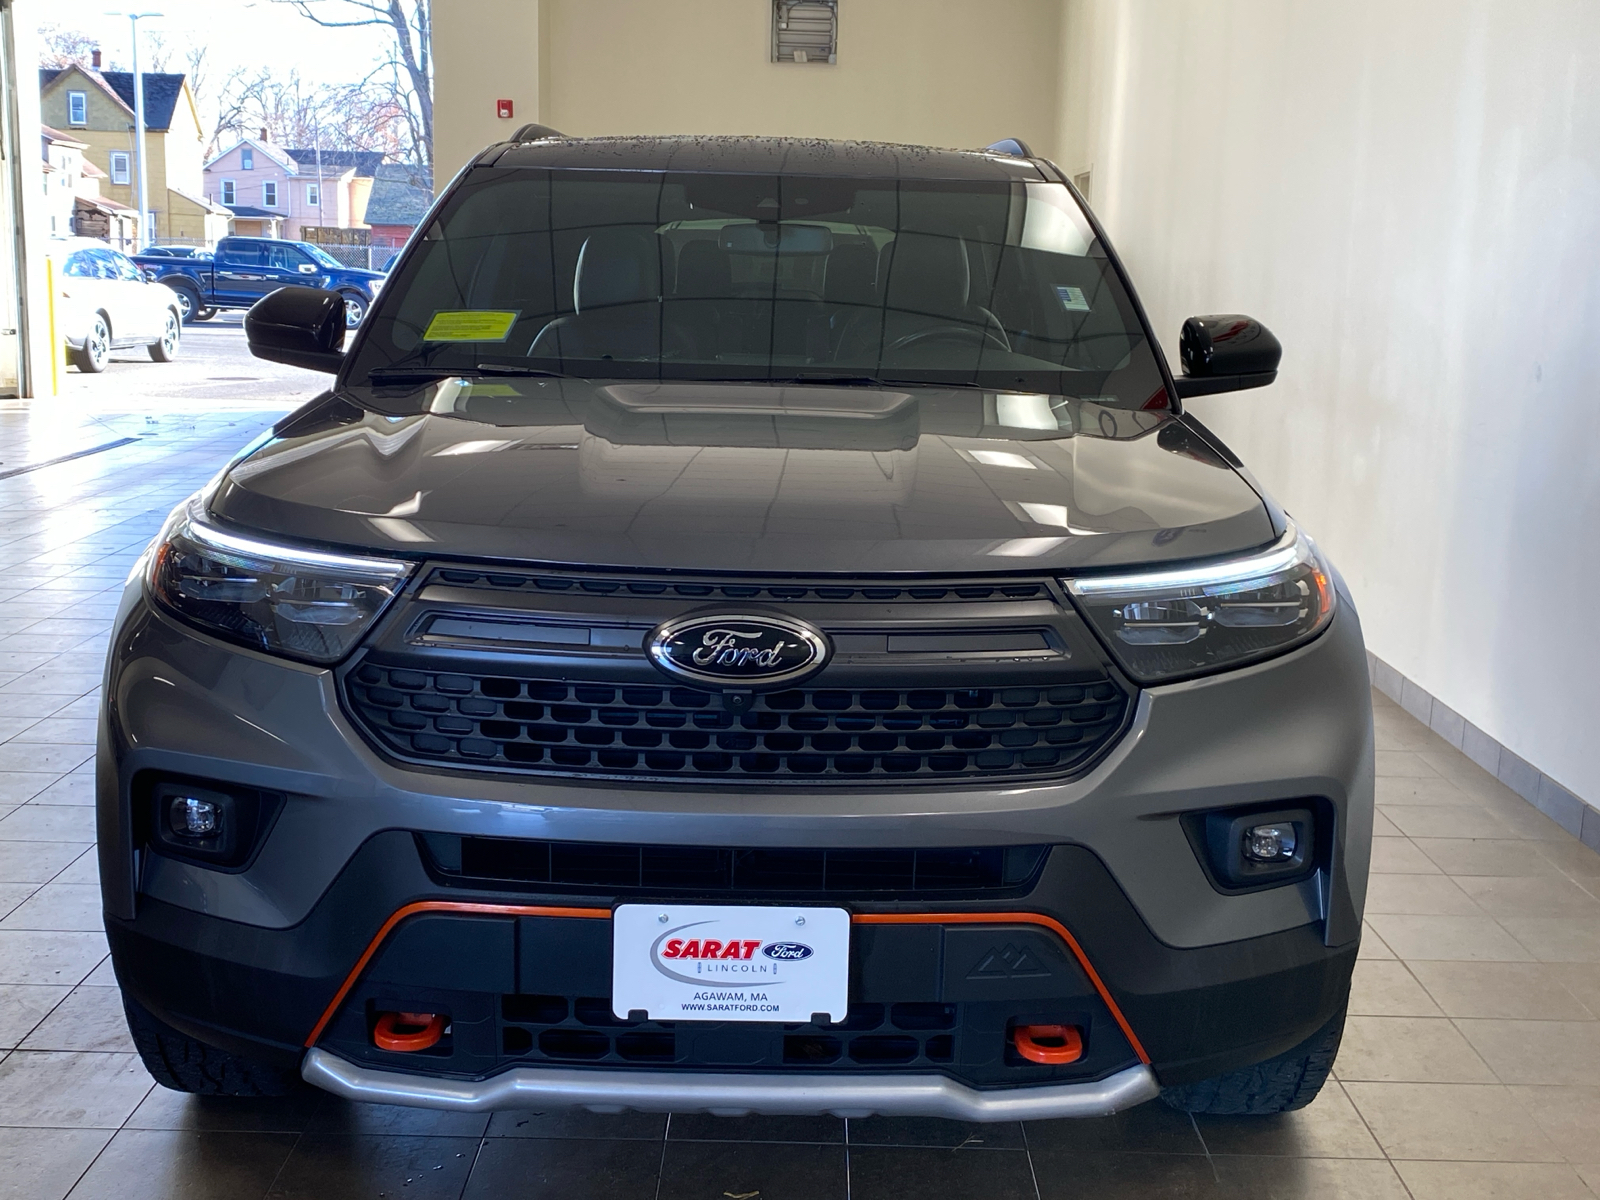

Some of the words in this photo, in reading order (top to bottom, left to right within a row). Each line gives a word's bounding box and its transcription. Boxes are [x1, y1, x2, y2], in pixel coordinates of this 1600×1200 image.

[692, 628, 785, 667] Ford
[662, 938, 763, 960] SARAT
[770, 944, 805, 959] Ford
[707, 964, 767, 973] LINCOLN
[693, 991, 747, 1002] AGAWAM,
[750, 992, 768, 1002] MA
[681, 1003, 780, 1012] WWW.SARATFORD.COM
